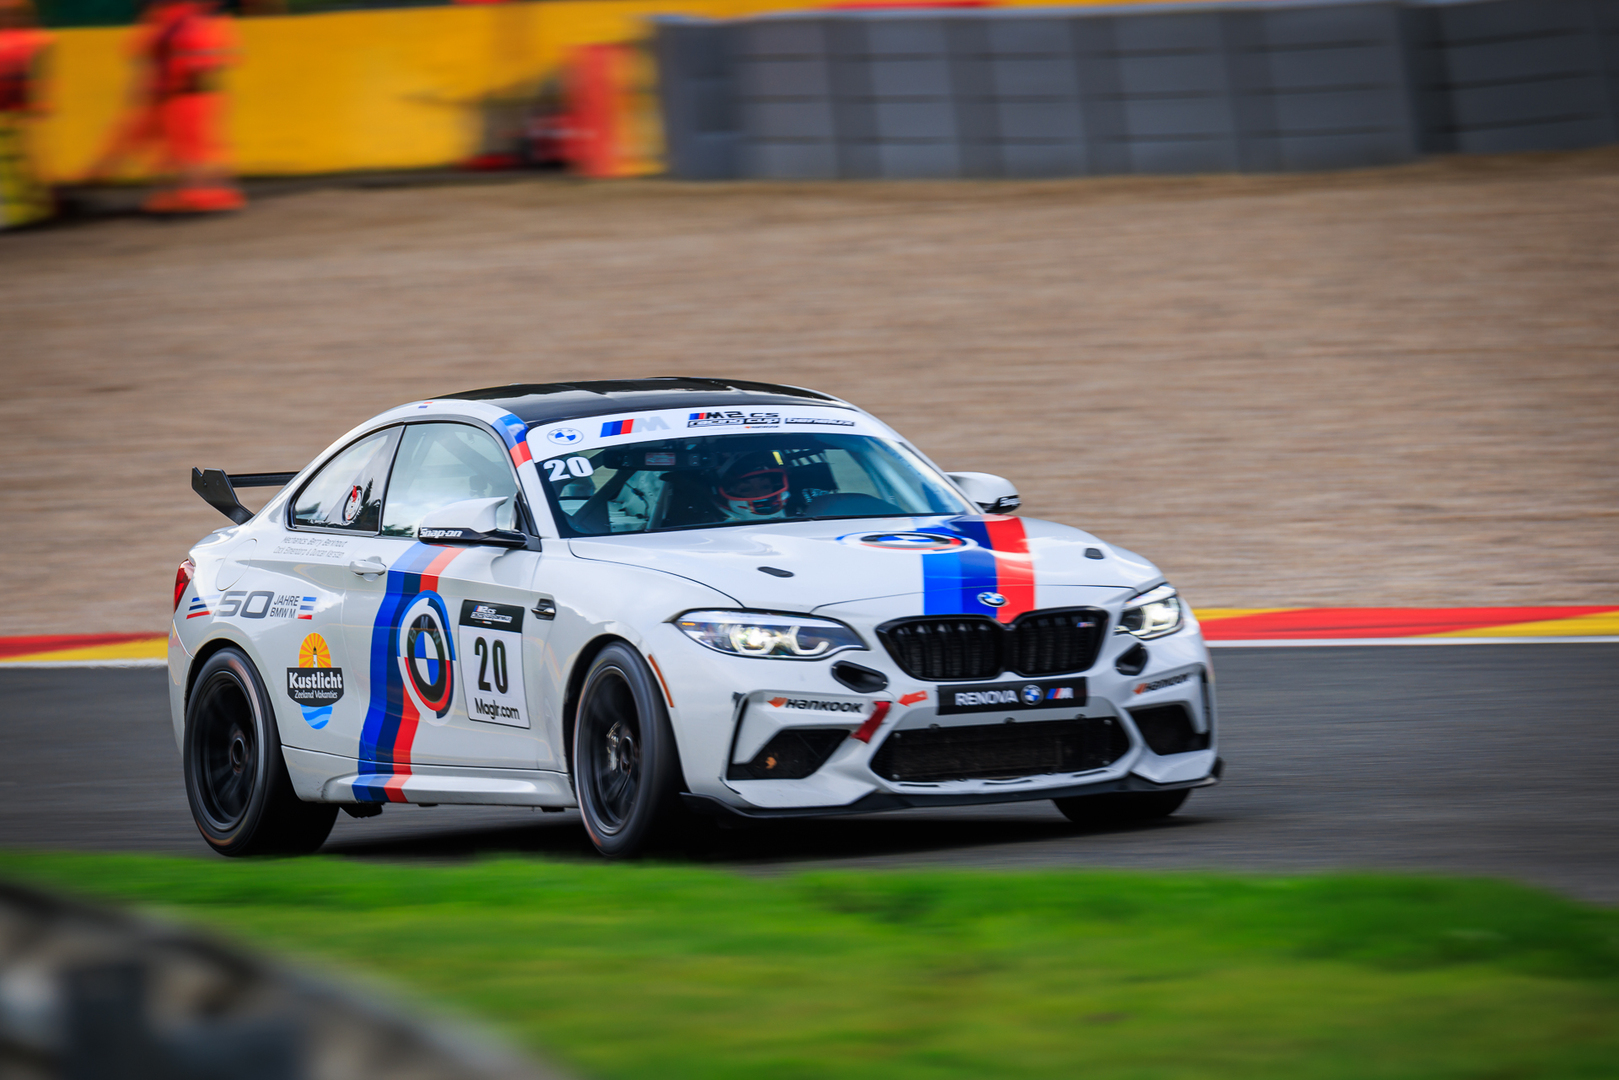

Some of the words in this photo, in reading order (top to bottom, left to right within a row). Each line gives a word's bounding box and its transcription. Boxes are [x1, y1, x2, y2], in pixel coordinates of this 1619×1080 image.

[543, 456, 594, 482] 20
[420, 528, 463, 538] Snap-on
[214, 590, 275, 619] 50
[273, 594, 300, 606] JAHRE
[270, 607, 289, 618] BMW
[288, 608, 297, 619] M
[474, 636, 508, 695] 20
[289, 671, 342, 689] Kustlicht
[294, 690, 314, 699] Zeeland
[314, 690, 338, 699] Vakanties
[955, 690, 1019, 706] RENOVA
[474, 697, 521, 720] Maglr.com
